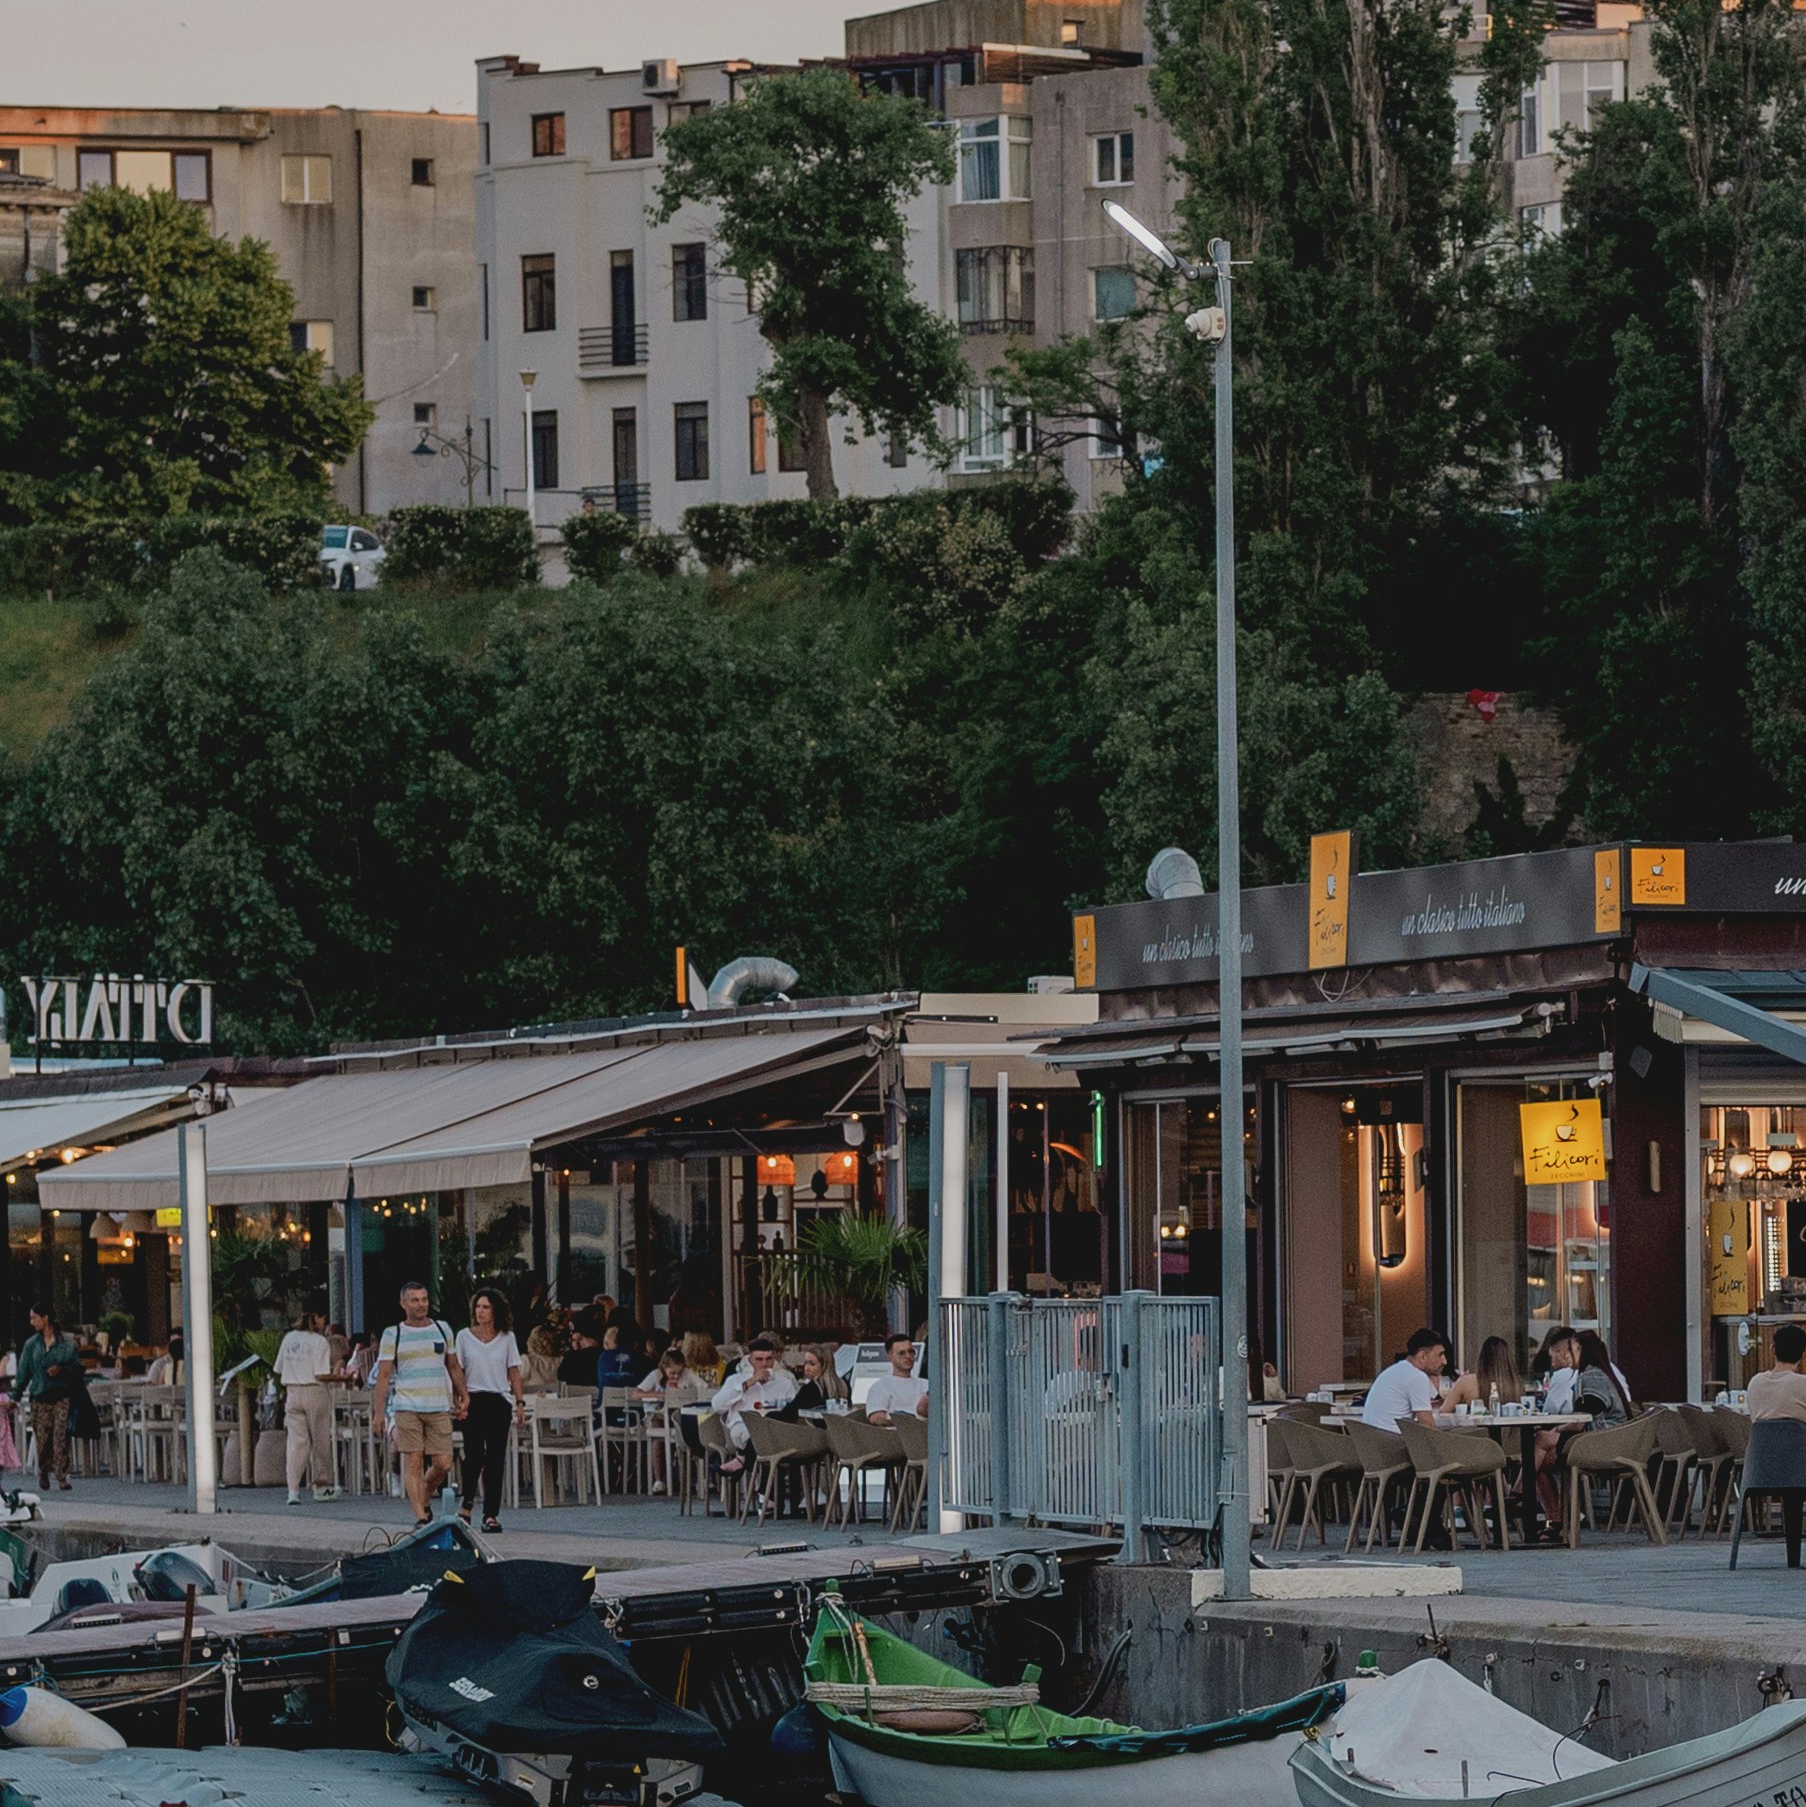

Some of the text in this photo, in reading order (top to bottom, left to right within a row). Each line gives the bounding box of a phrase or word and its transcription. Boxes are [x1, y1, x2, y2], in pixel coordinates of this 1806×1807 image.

[1401, 885, 1525, 936] un clasico tutto italiano
[1530, 1147, 1599, 1172] Filicori
